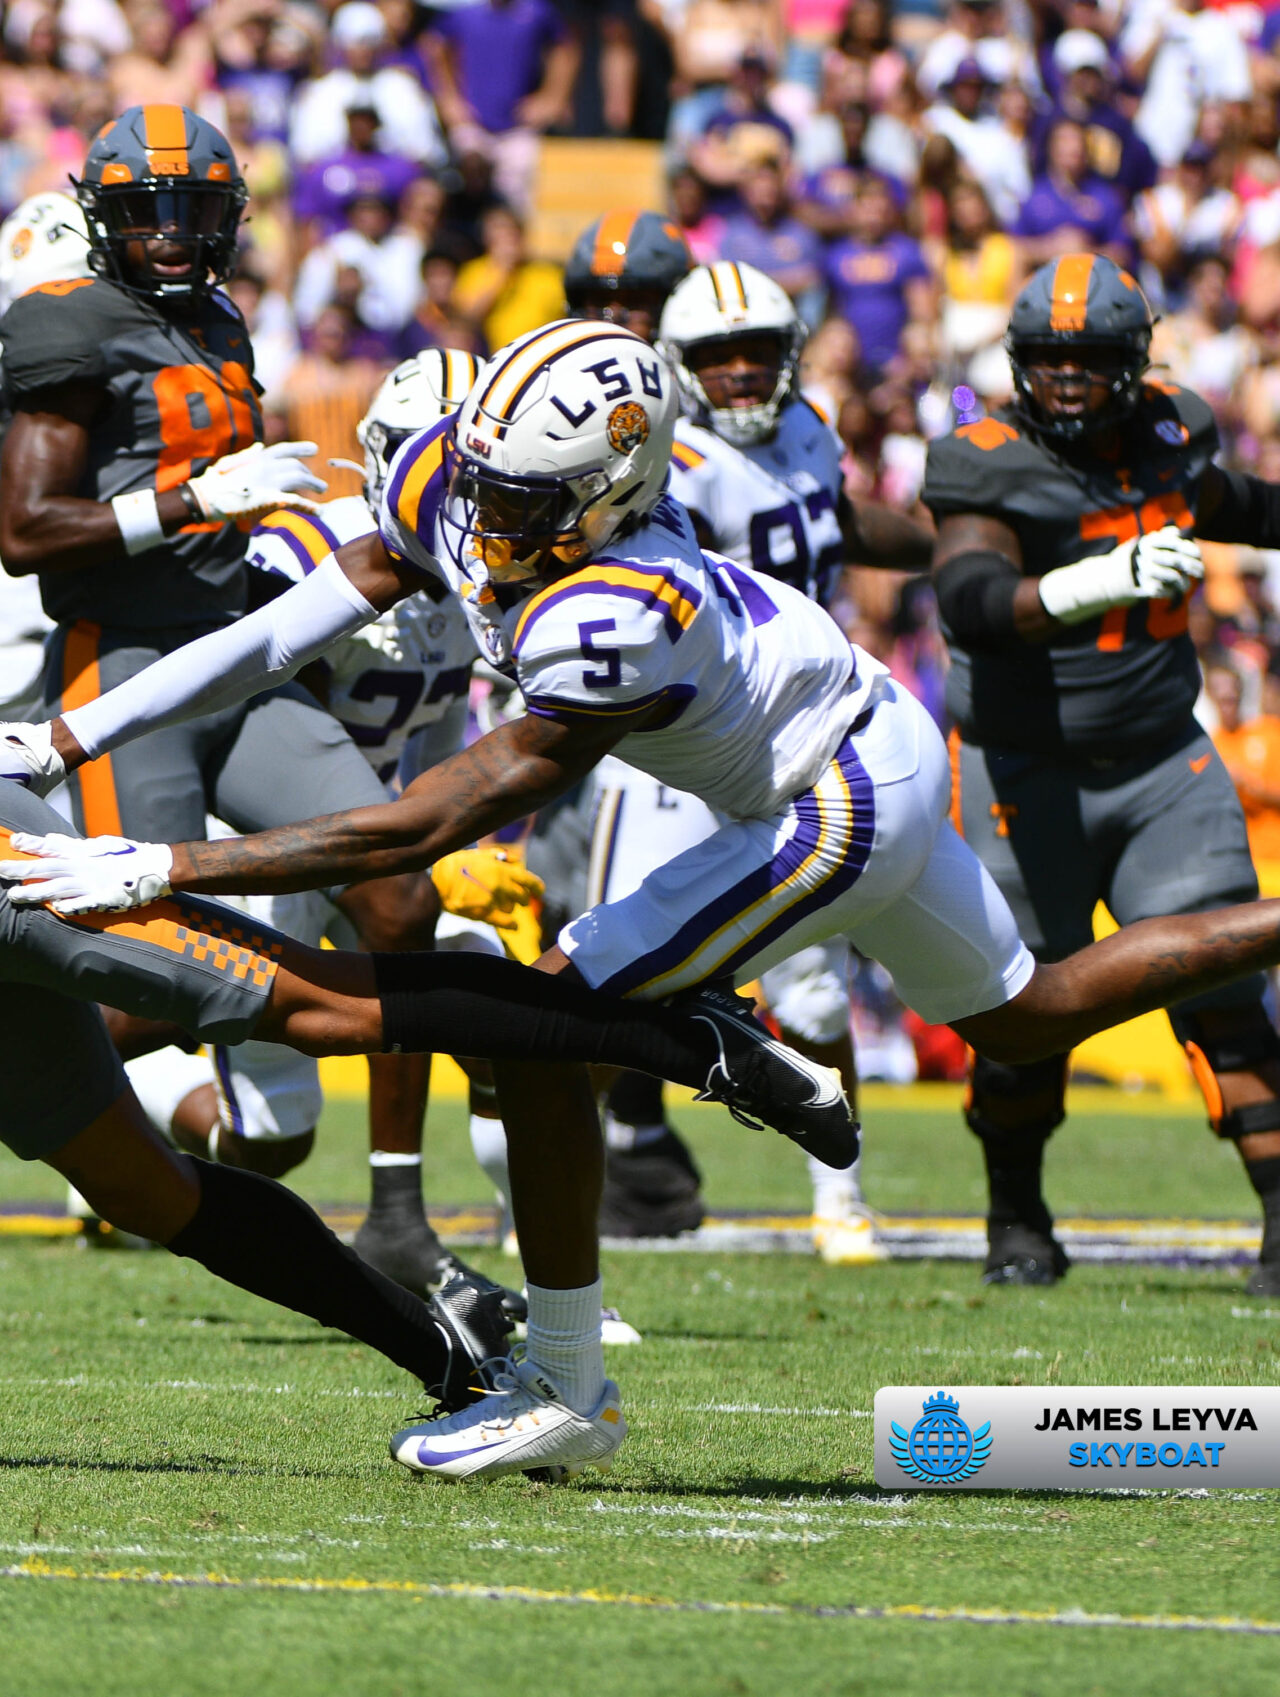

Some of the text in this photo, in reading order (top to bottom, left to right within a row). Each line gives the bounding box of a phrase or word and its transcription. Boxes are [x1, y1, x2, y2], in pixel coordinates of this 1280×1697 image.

[465, 432, 492, 460] LSU
[578, 618, 617, 688] 5
[536, 1377, 558, 1400] LSU
